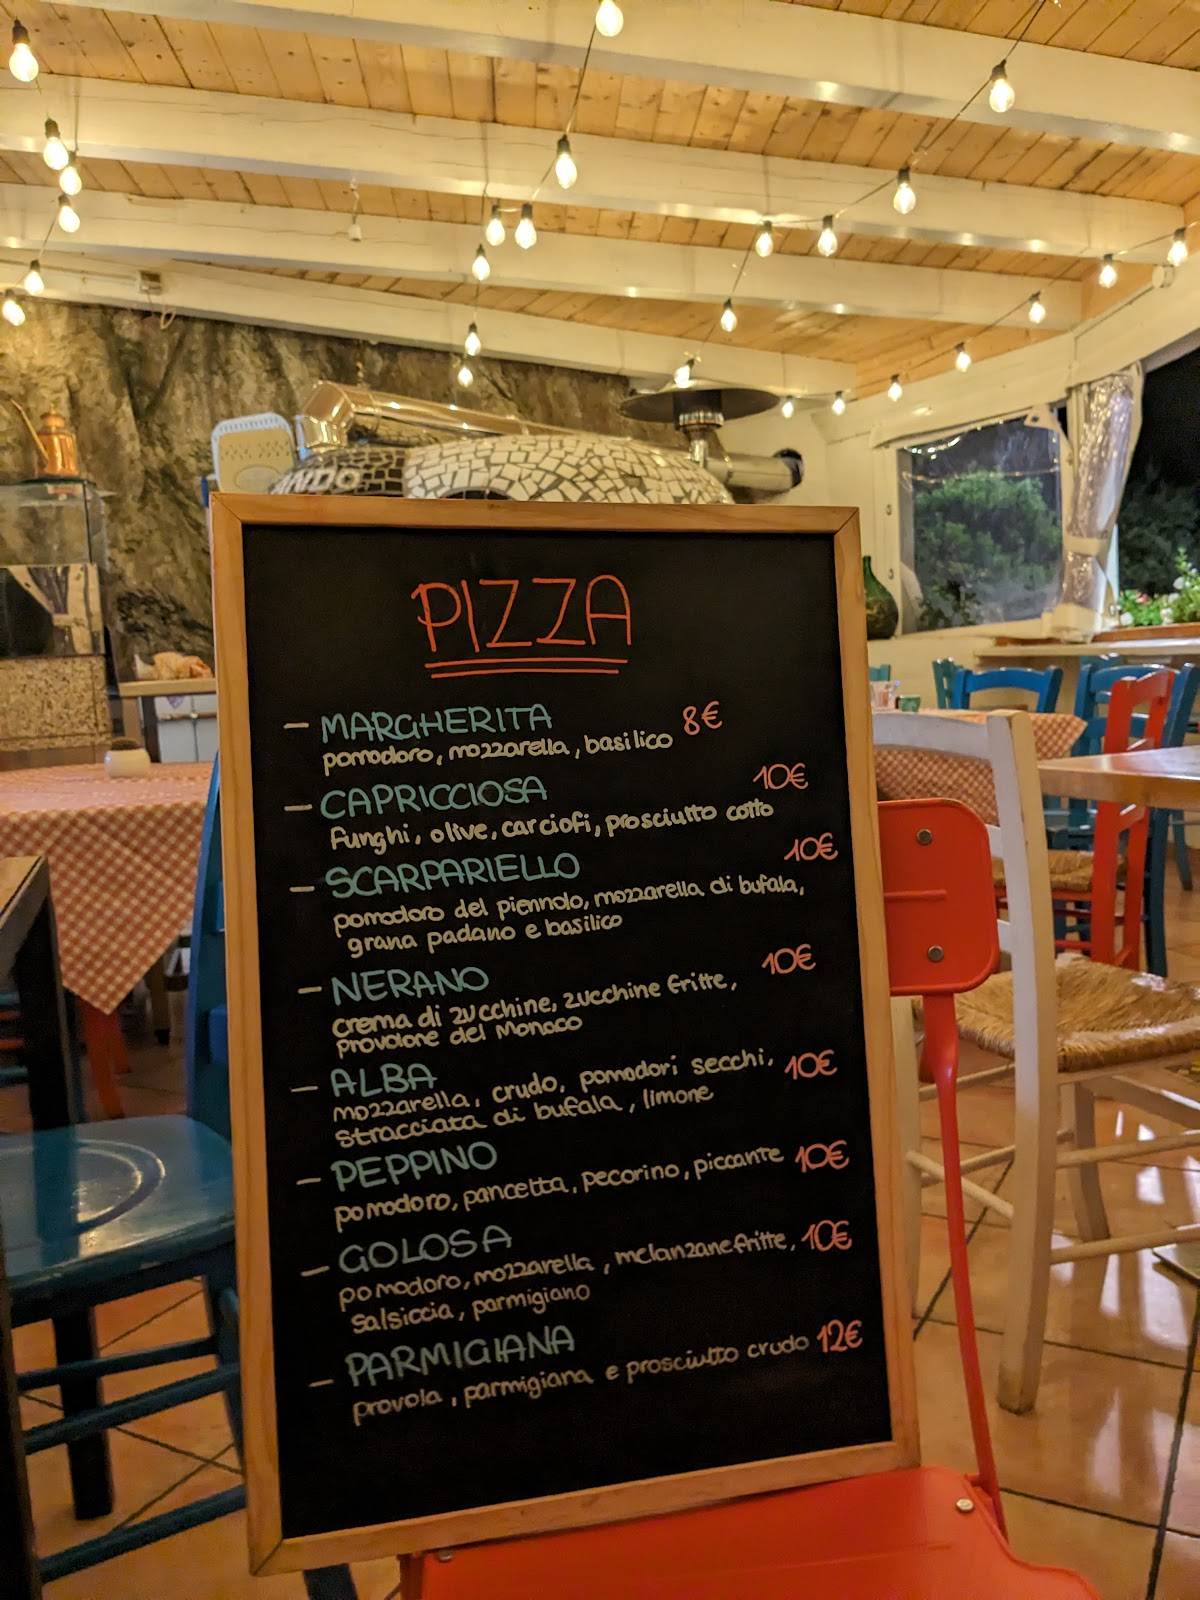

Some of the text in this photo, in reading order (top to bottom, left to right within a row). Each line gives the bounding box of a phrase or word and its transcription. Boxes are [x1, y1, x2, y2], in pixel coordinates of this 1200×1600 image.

[411, 575, 631, 653] PIZZA
[322, 704, 552, 743] MARGHERITA
[683, 701, 722, 735] 8€
[584, 730, 673, 754] basilico
[753, 763, 808, 789] 10€
[321, 776, 547, 819] CAPRICCIOSA
[605, 804, 717, 837] prosciutto
[726, 798, 774, 821] cotto
[784, 832, 838, 861] 10€
[325, 853, 580, 900] SCARPARIELLO
[333, 905, 445, 938] pomodoro
[455, 898, 488, 918] del
[594, 881, 705, 907] mozzarella
[710, 875, 733, 894] di
[348, 914, 623, 958] grana padano e basilico
[762, 944, 816, 974] 10€
[332, 967, 489, 1005] NERANO
[332, 1014, 413, 1038] crema
[418, 1005, 442, 1027] di
[563, 982, 661, 1008] zucchine
[450, 1023, 486, 1045] del
[331, 1064, 437, 1097] ALBA
[580, 1055, 677, 1093] pomodori
[784, 1049, 837, 1080] 10€
[335, 1115, 487, 1148] stracciata
[493, 1108, 525, 1126] di
[643, 1086, 714, 1109] limone
[331, 1142, 497, 1191] PEPPINO
[694, 1147, 784, 1180] piccante
[795, 1140, 849, 1172] 10€
[340, 1225, 512, 1273] GOLOSA
[801, 1220, 852, 1251] 10€
[472, 1285, 590, 1321] parmigiano
[817, 1320, 862, 1353] 12€
[346, 1326, 574, 1388] PARMIGIANA
[464, 1370, 593, 1408] parmigiana
[606, 1366, 619, 1380] e
[626, 1347, 739, 1383] prosciutto
[748, 1335, 809, 1358] crudo
